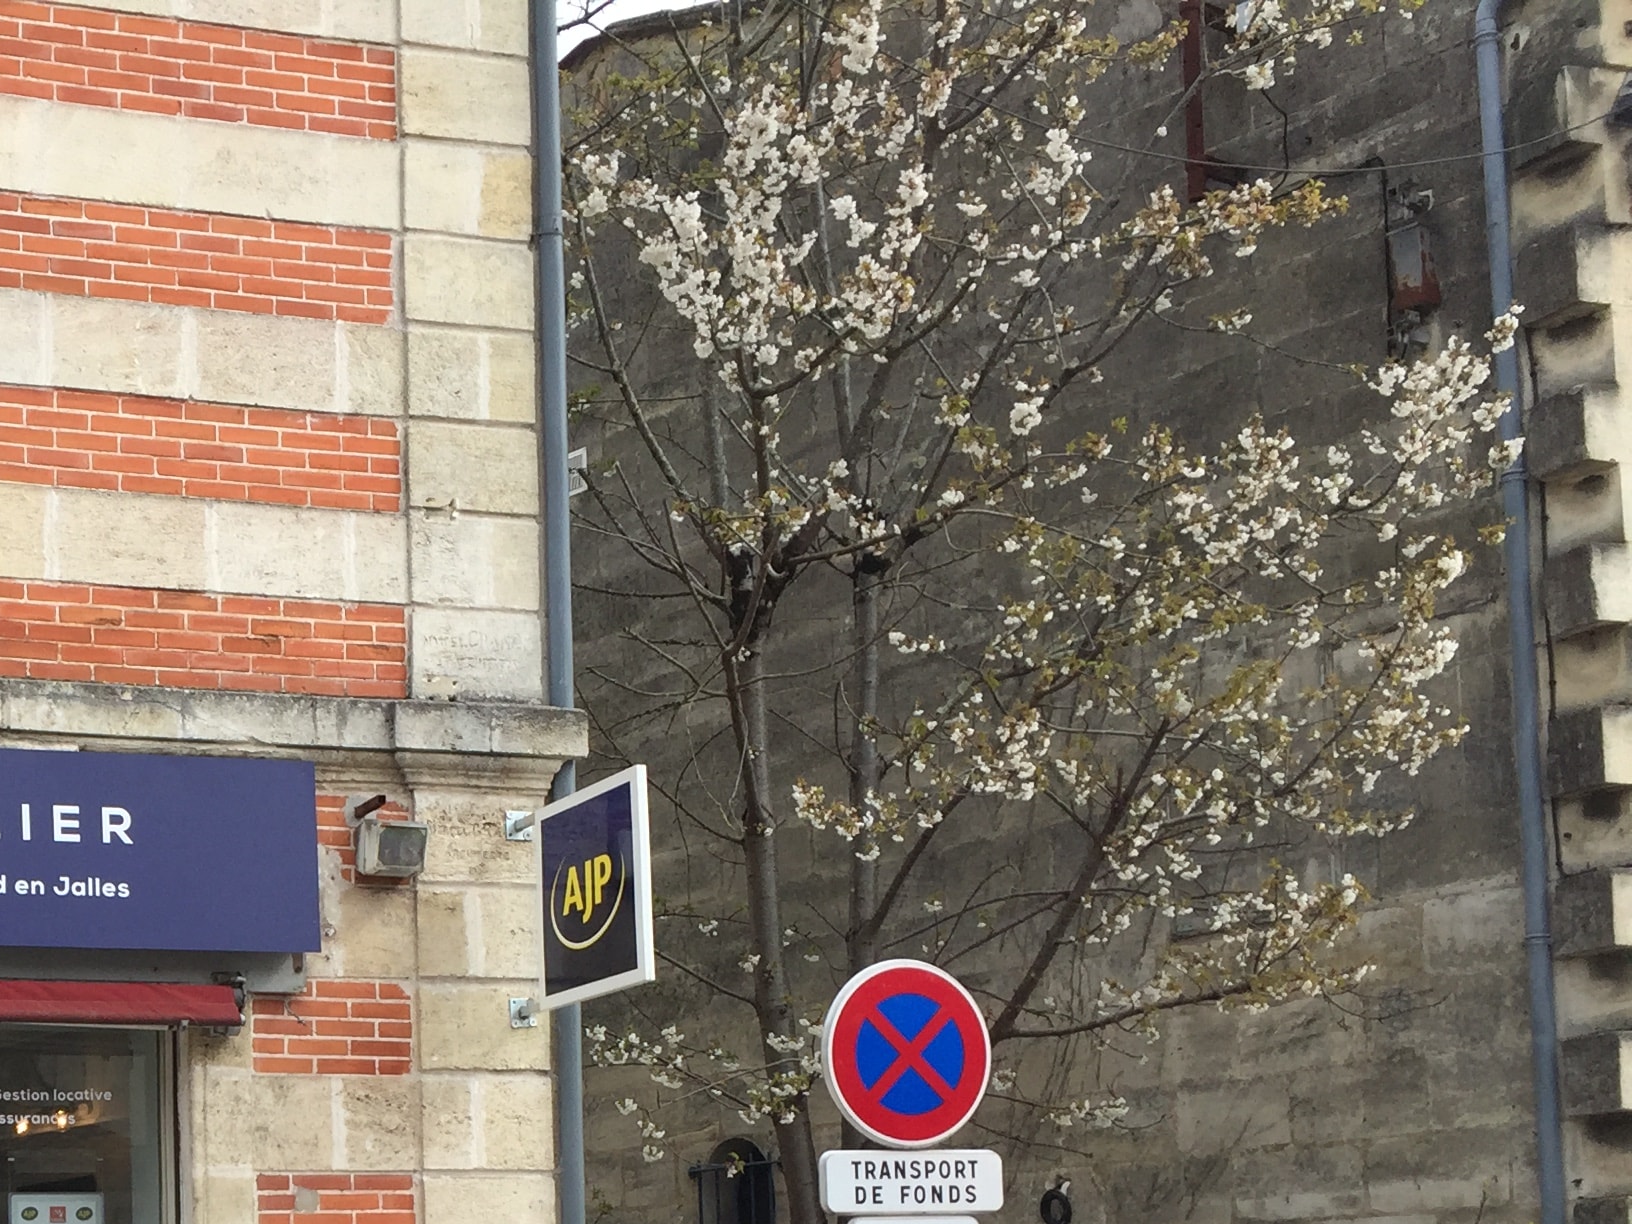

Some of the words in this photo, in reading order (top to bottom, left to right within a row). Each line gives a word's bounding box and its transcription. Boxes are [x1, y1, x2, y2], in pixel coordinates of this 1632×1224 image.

[14, 878, 45, 896] en
[53, 876, 131, 899] Jalles
[563, 854, 612, 924] AJP
[54, 1088, 112, 1101] locative
[851, 1160, 978, 1180] TRANSPORT
[855, 1186, 884, 1204] DE
[900, 1185, 977, 1204] FONDS
